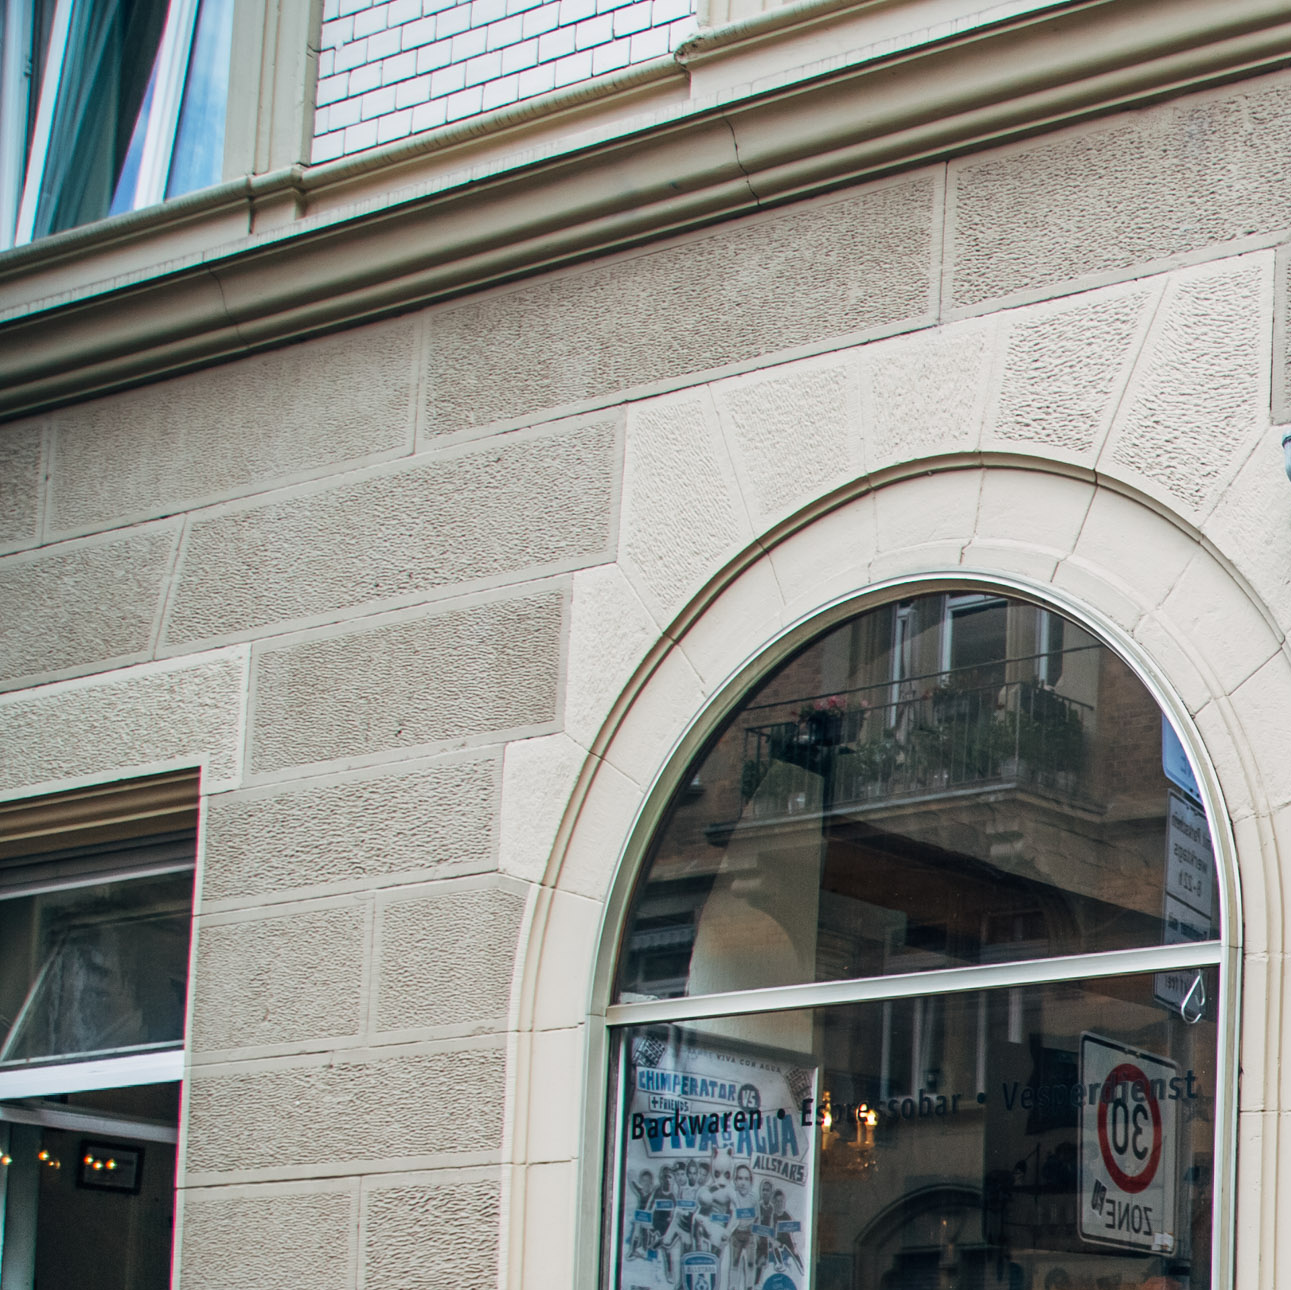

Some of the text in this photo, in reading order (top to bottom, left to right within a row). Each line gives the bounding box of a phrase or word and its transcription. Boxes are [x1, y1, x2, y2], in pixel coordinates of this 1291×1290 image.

[638, 1069, 738, 1102] CHIMPERATOR
[631, 1108, 762, 1140] Backwaren
[801, 1089, 962, 1128] Espressobar
[1002, 1069, 1198, 1114] Vesperdienst
[752, 1153, 806, 1183] ALLSTARS
